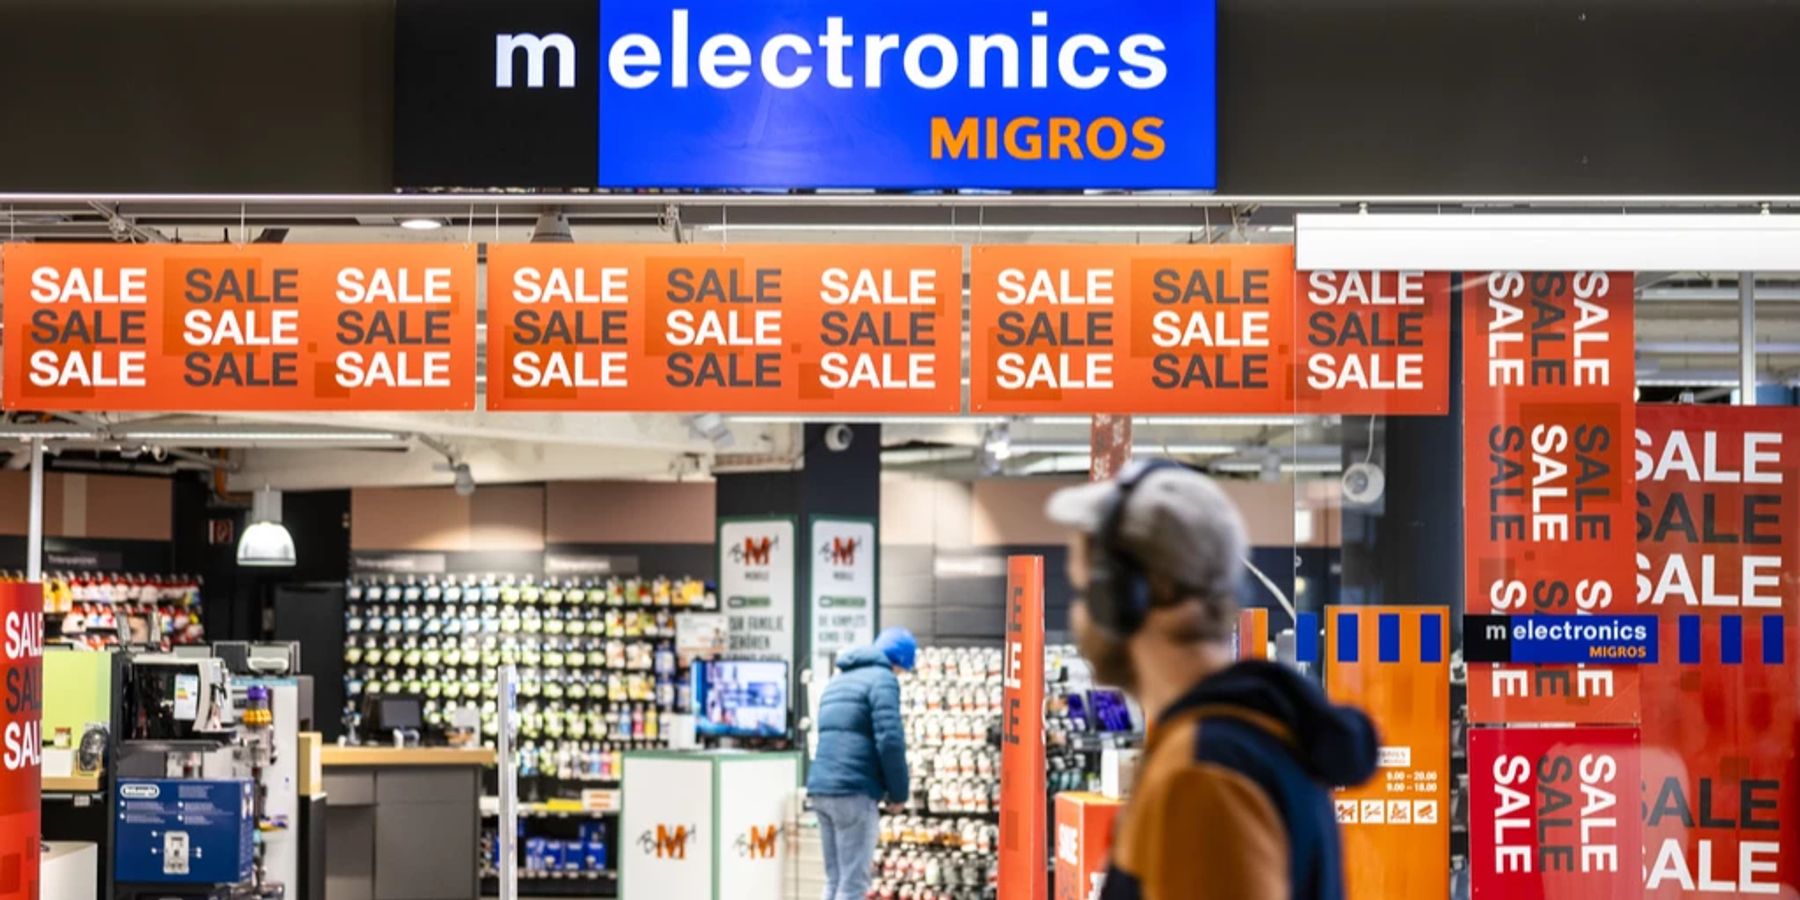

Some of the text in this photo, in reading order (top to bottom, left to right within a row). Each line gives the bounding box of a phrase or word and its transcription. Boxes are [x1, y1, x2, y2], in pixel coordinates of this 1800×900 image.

[496, 9, 1167, 89] m electronics
[930, 117, 1166, 160] MIGROS
[31, 267, 451, 303] SALE SALE SALE
[513, 267, 936, 304] SALE SALE SALE
[997, 268, 1424, 305] SALE SALE SALE
[32, 310, 449, 345] SALE SALE SALE
[514, 310, 934, 345] SALE SALE SALE
[998, 311, 1424, 346] SALE SALE SALE
[1488, 271, 1524, 386] SALE
[1530, 271, 1566, 386] SALE
[1574, 271, 1609, 386] SALE
[30, 351, 450, 387] SALE SALE SALE
[513, 352, 935, 388] SALE SALE SALE
[997, 353, 1423, 389] SALE SALE SALE
[1489, 425, 1524, 541] SALE
[1531, 424, 1568, 542] SALE
[1574, 425, 1609, 541] SALE
[1486, 620, 1647, 640] m electronics
[1491, 580, 1528, 697] SE
[1533, 580, 1569, 697] SE
[1576, 580, 1614, 697] SE
[1589, 646, 1647, 658] MIGROS
[6, 668, 42, 714] SAL
[4, 721, 42, 770] SAL
[1493, 755, 1532, 873] SALE
[1536, 755, 1574, 872] SALE
[1579, 754, 1618, 872] SALE
[1641, 776, 1780, 830] ALE
[1642, 838, 1780, 894] ALE
